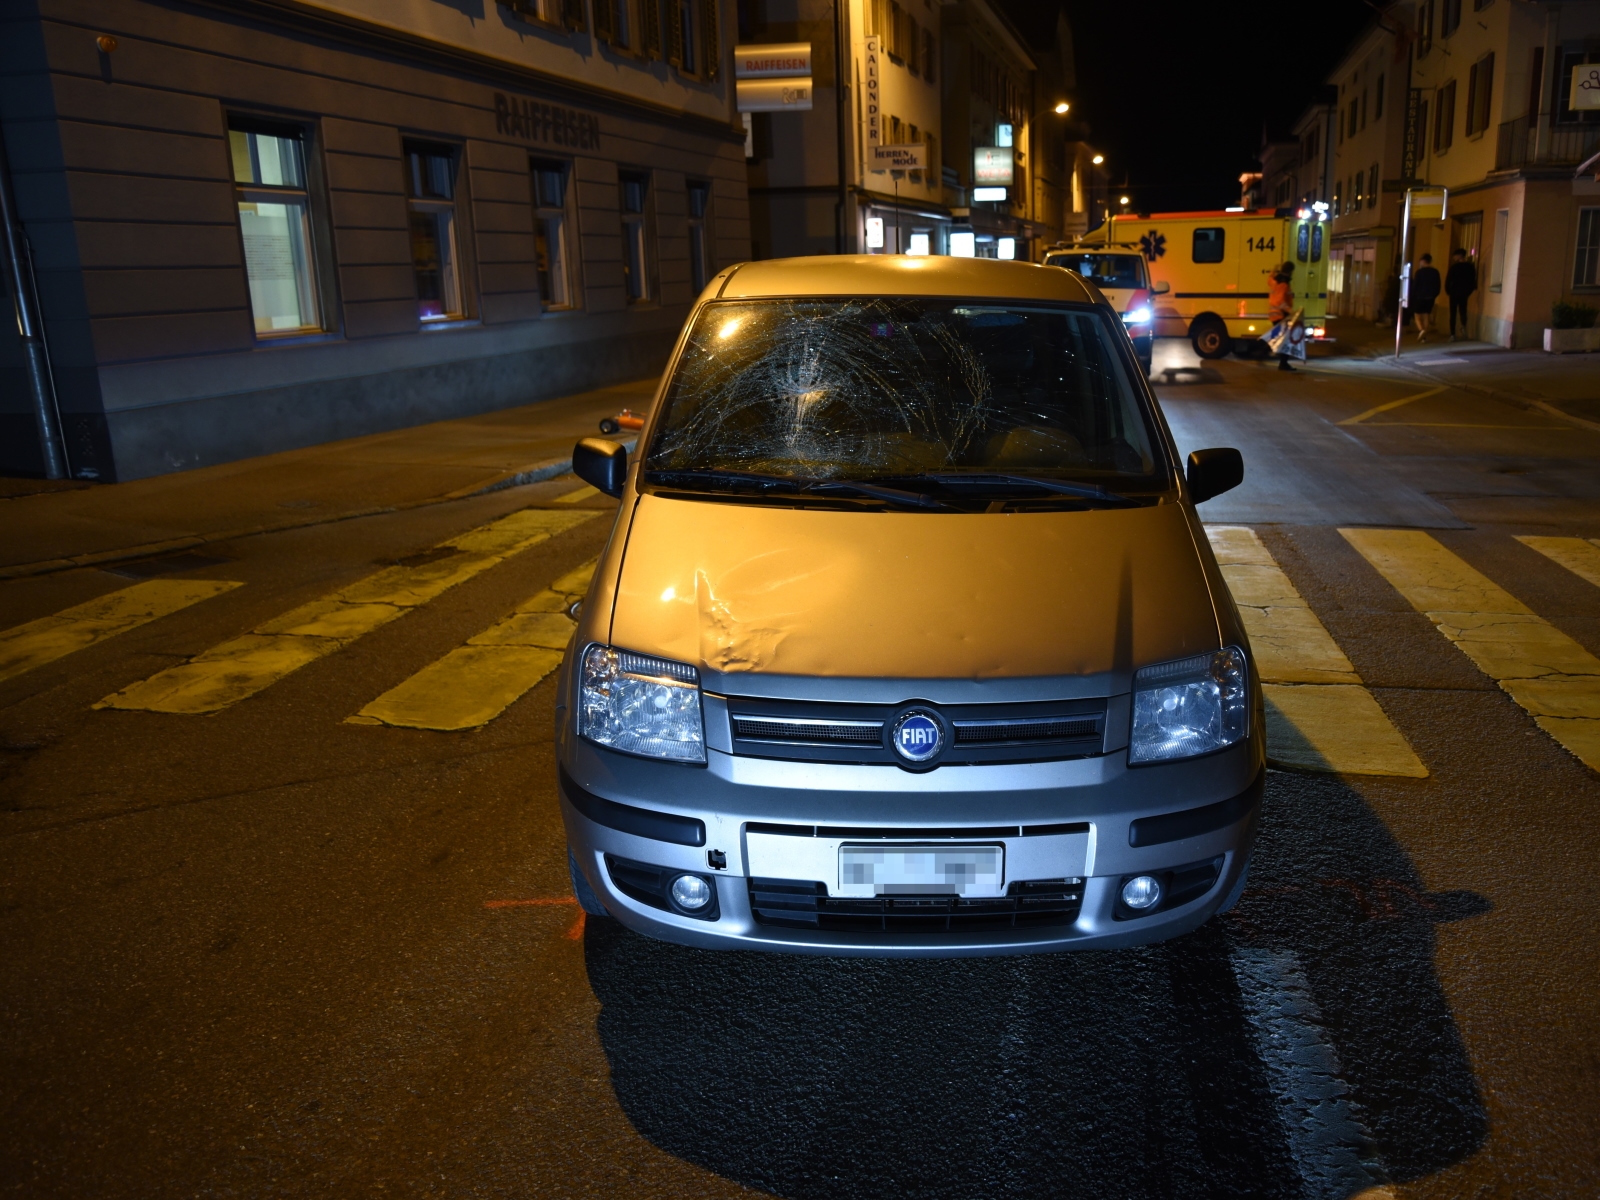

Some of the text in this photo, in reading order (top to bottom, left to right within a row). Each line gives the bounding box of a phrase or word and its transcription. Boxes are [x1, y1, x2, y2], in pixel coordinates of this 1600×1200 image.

[745, 58, 806, 72] RAIFFEISEN
[867, 41, 878, 139] CALONDER
[494, 91, 601, 151] RAIFFEISEN
[1404, 90, 1418, 178] RESTAURANT
[1246, 236, 1276, 252] 144
[902, 727, 936, 745] FIAT
